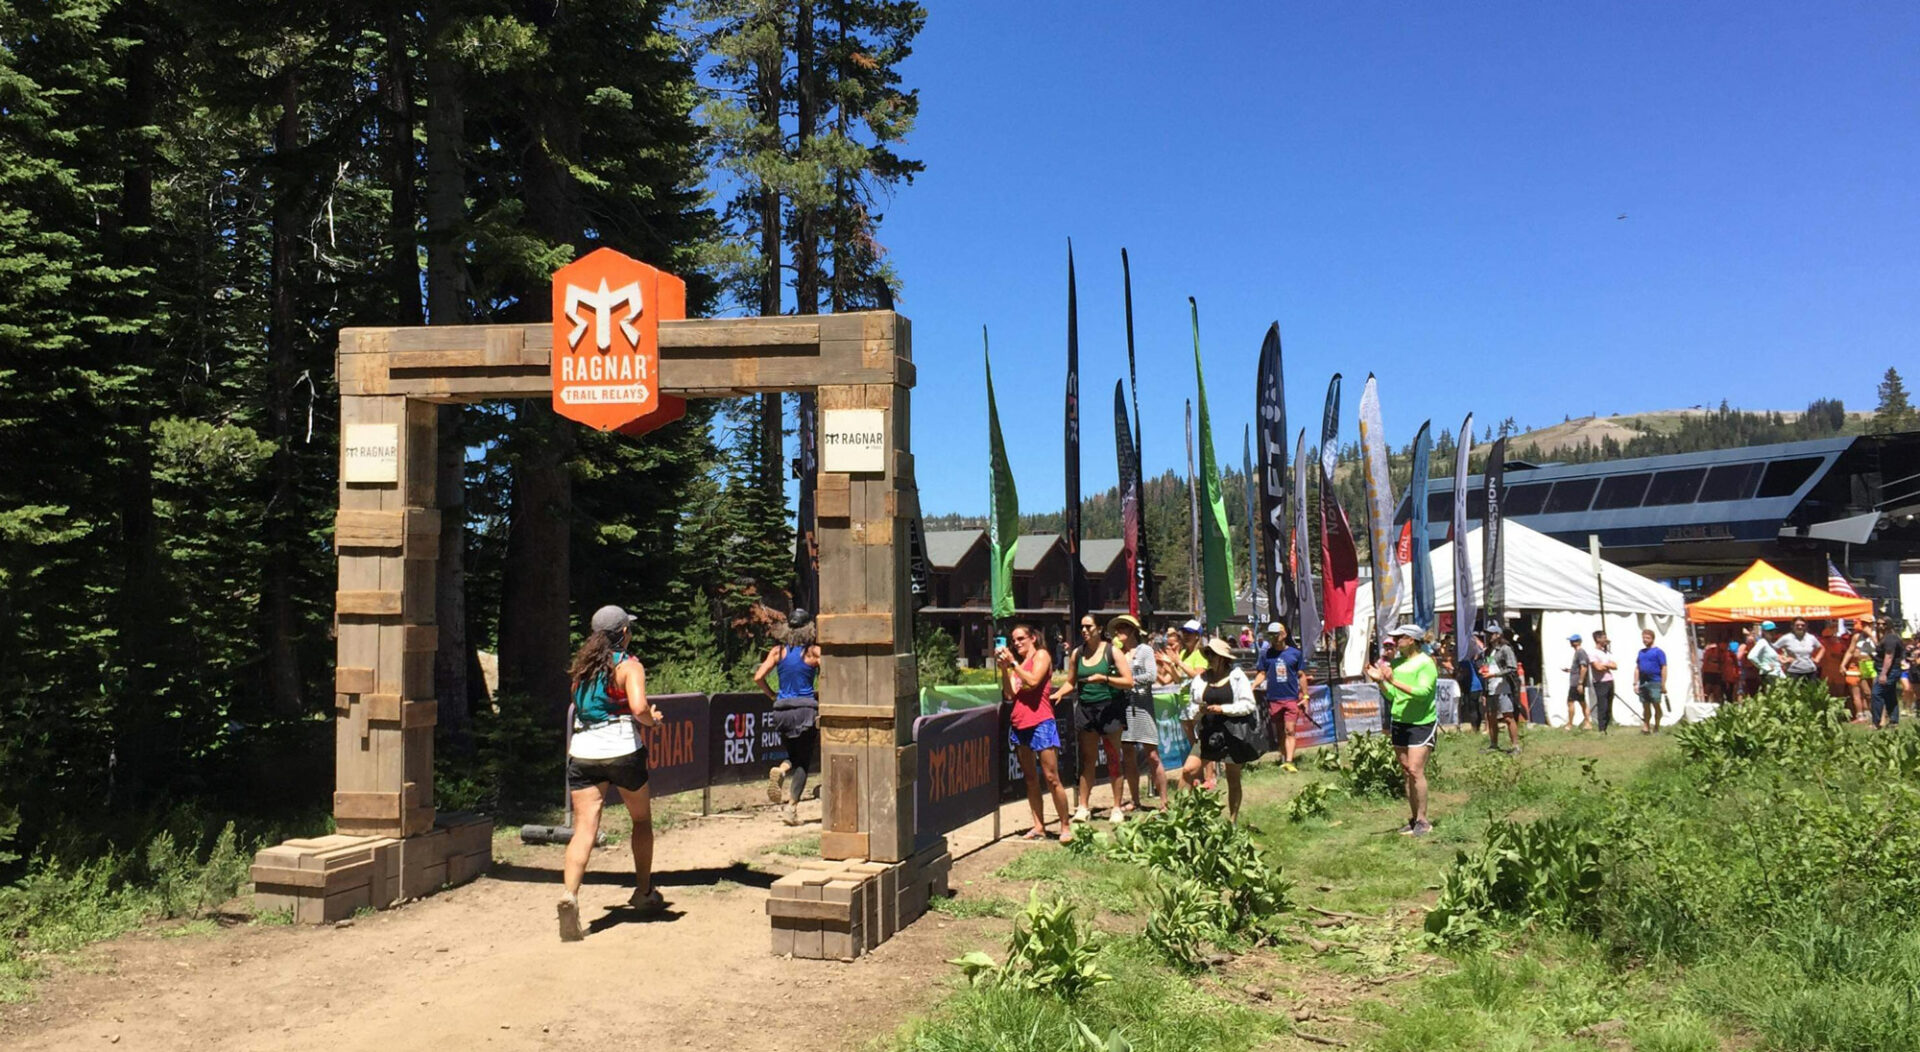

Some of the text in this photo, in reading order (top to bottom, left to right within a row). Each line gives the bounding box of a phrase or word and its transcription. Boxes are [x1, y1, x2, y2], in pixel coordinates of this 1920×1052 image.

[562, 354, 647, 381] RAGNAR
[566, 388, 644, 401] TRAIL RELAYS
[360, 446, 396, 457] RAGNAR
[842, 432, 883, 445] RAGNAR
[724, 713, 755, 739] CUR
[640, 720, 694, 769] GNAR
[724, 738, 755, 766] REX
[947, 735, 990, 797] RAGNAR
